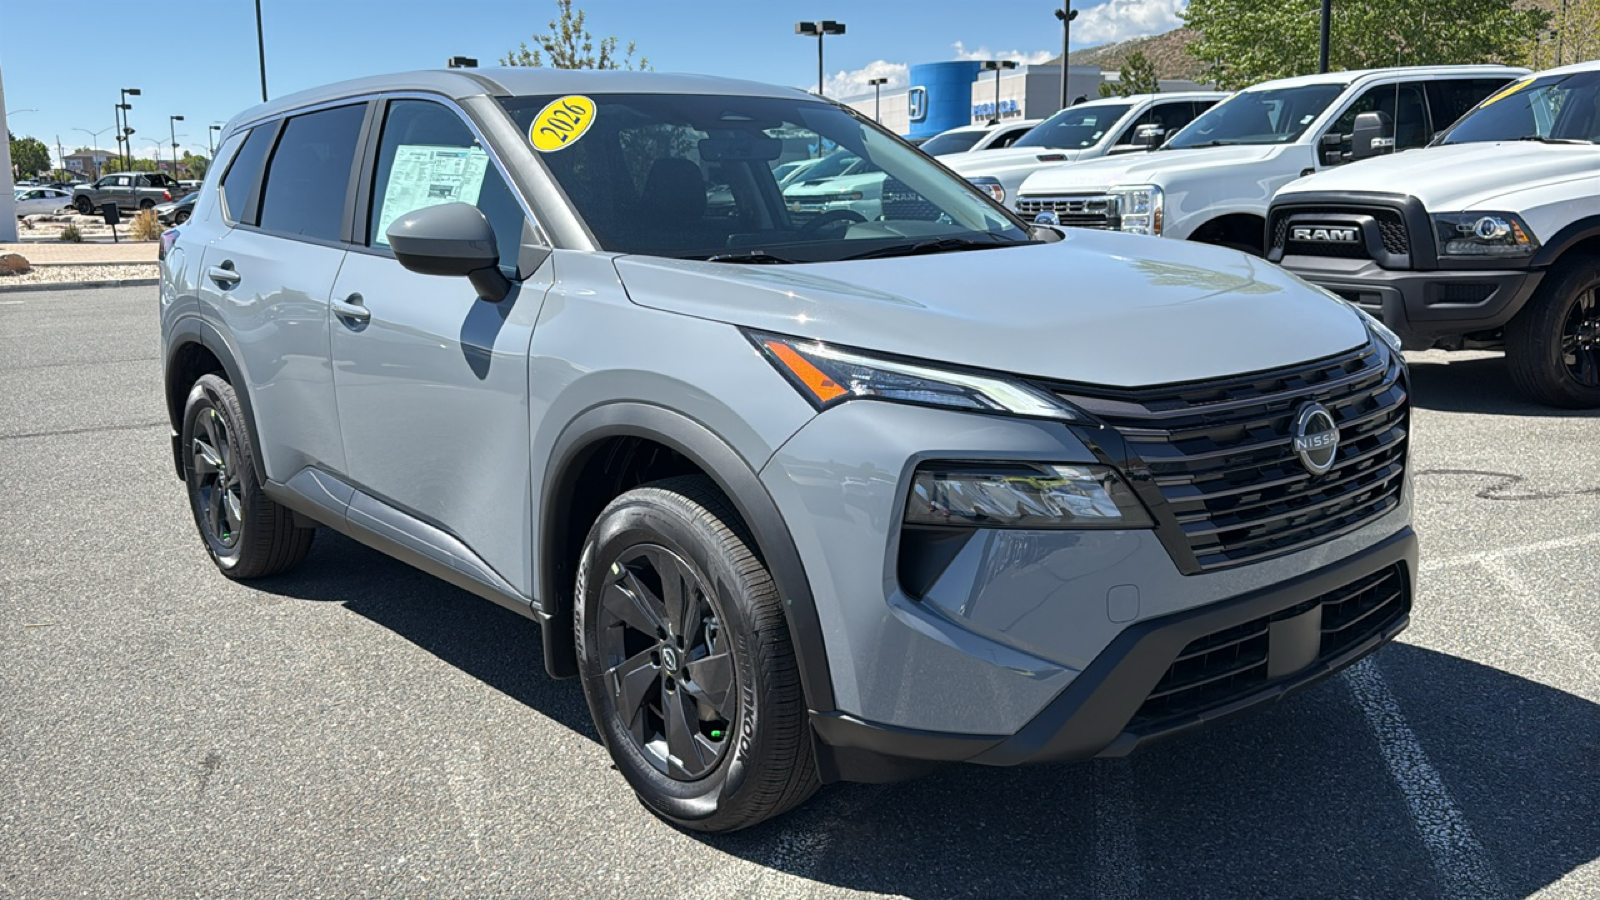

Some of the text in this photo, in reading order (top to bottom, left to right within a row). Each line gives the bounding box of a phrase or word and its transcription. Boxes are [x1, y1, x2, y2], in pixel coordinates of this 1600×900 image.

[540, 100, 586, 142] 2026
[1293, 228, 1355, 241] RAM
[1296, 432, 1337, 450] NISSA
